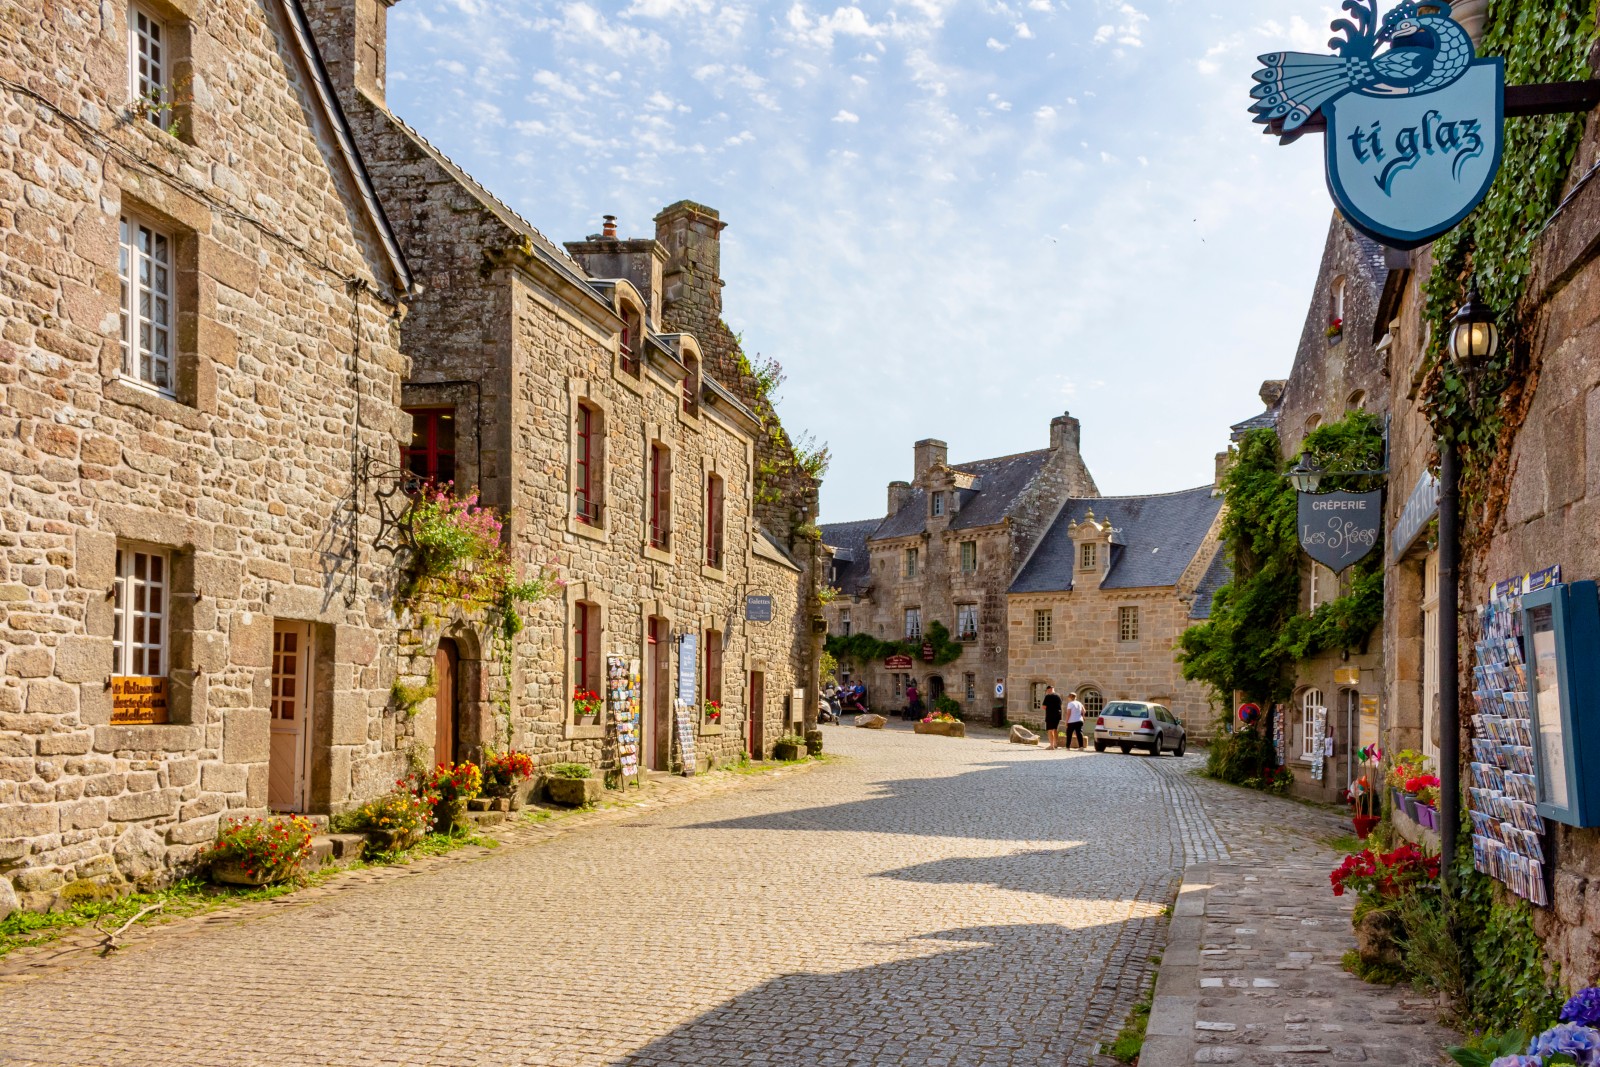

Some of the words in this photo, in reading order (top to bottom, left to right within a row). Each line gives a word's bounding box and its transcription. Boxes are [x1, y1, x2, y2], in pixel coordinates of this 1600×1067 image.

[1347, 119, 1385, 165] ti
[1374, 109, 1484, 197] glaz
[1312, 499, 1367, 511] CRÊPERIE
[1302, 524, 1326, 546] Les
[1327, 516, 1343, 549] 3
[1341, 521, 1376, 559] fées
